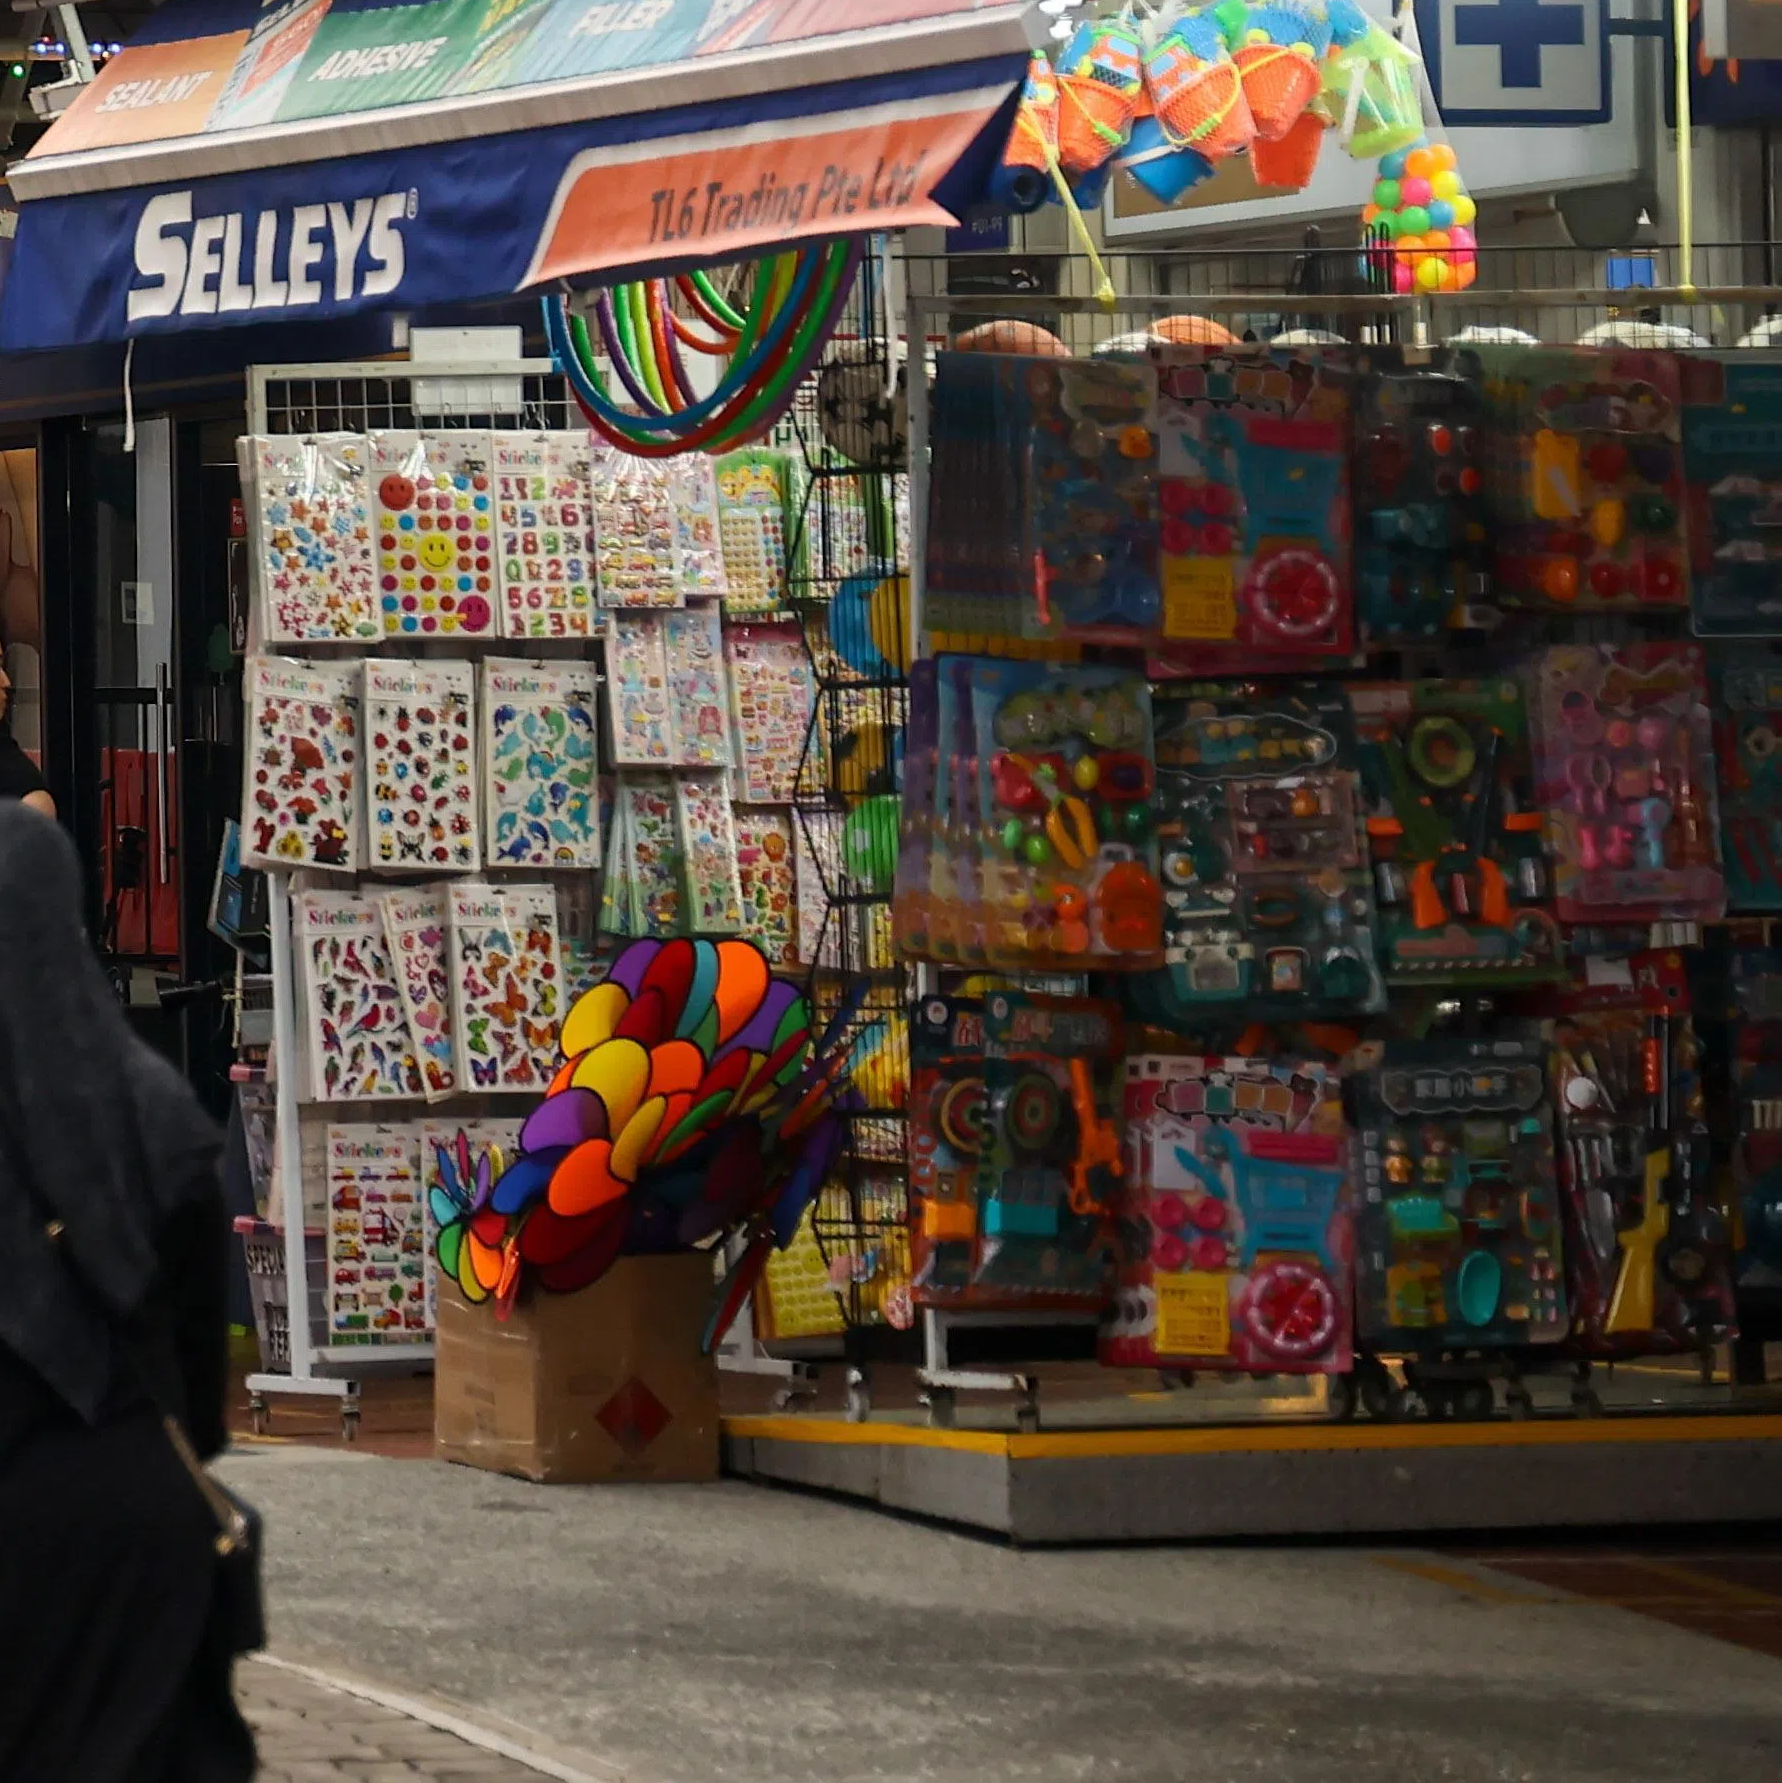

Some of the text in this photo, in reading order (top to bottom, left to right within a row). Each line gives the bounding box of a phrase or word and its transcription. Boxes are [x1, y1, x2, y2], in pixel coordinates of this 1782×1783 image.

[309, 36, 448, 82] ADHESIVE
[95, 70, 212, 113] SEALANT
[702, 173, 810, 237] Trading
[812, 164, 861, 218] Pte
[127, 191, 407, 321] SELLEYS
[260, 671, 325, 695] Stickers
[492, 674, 556, 693] Stickers
